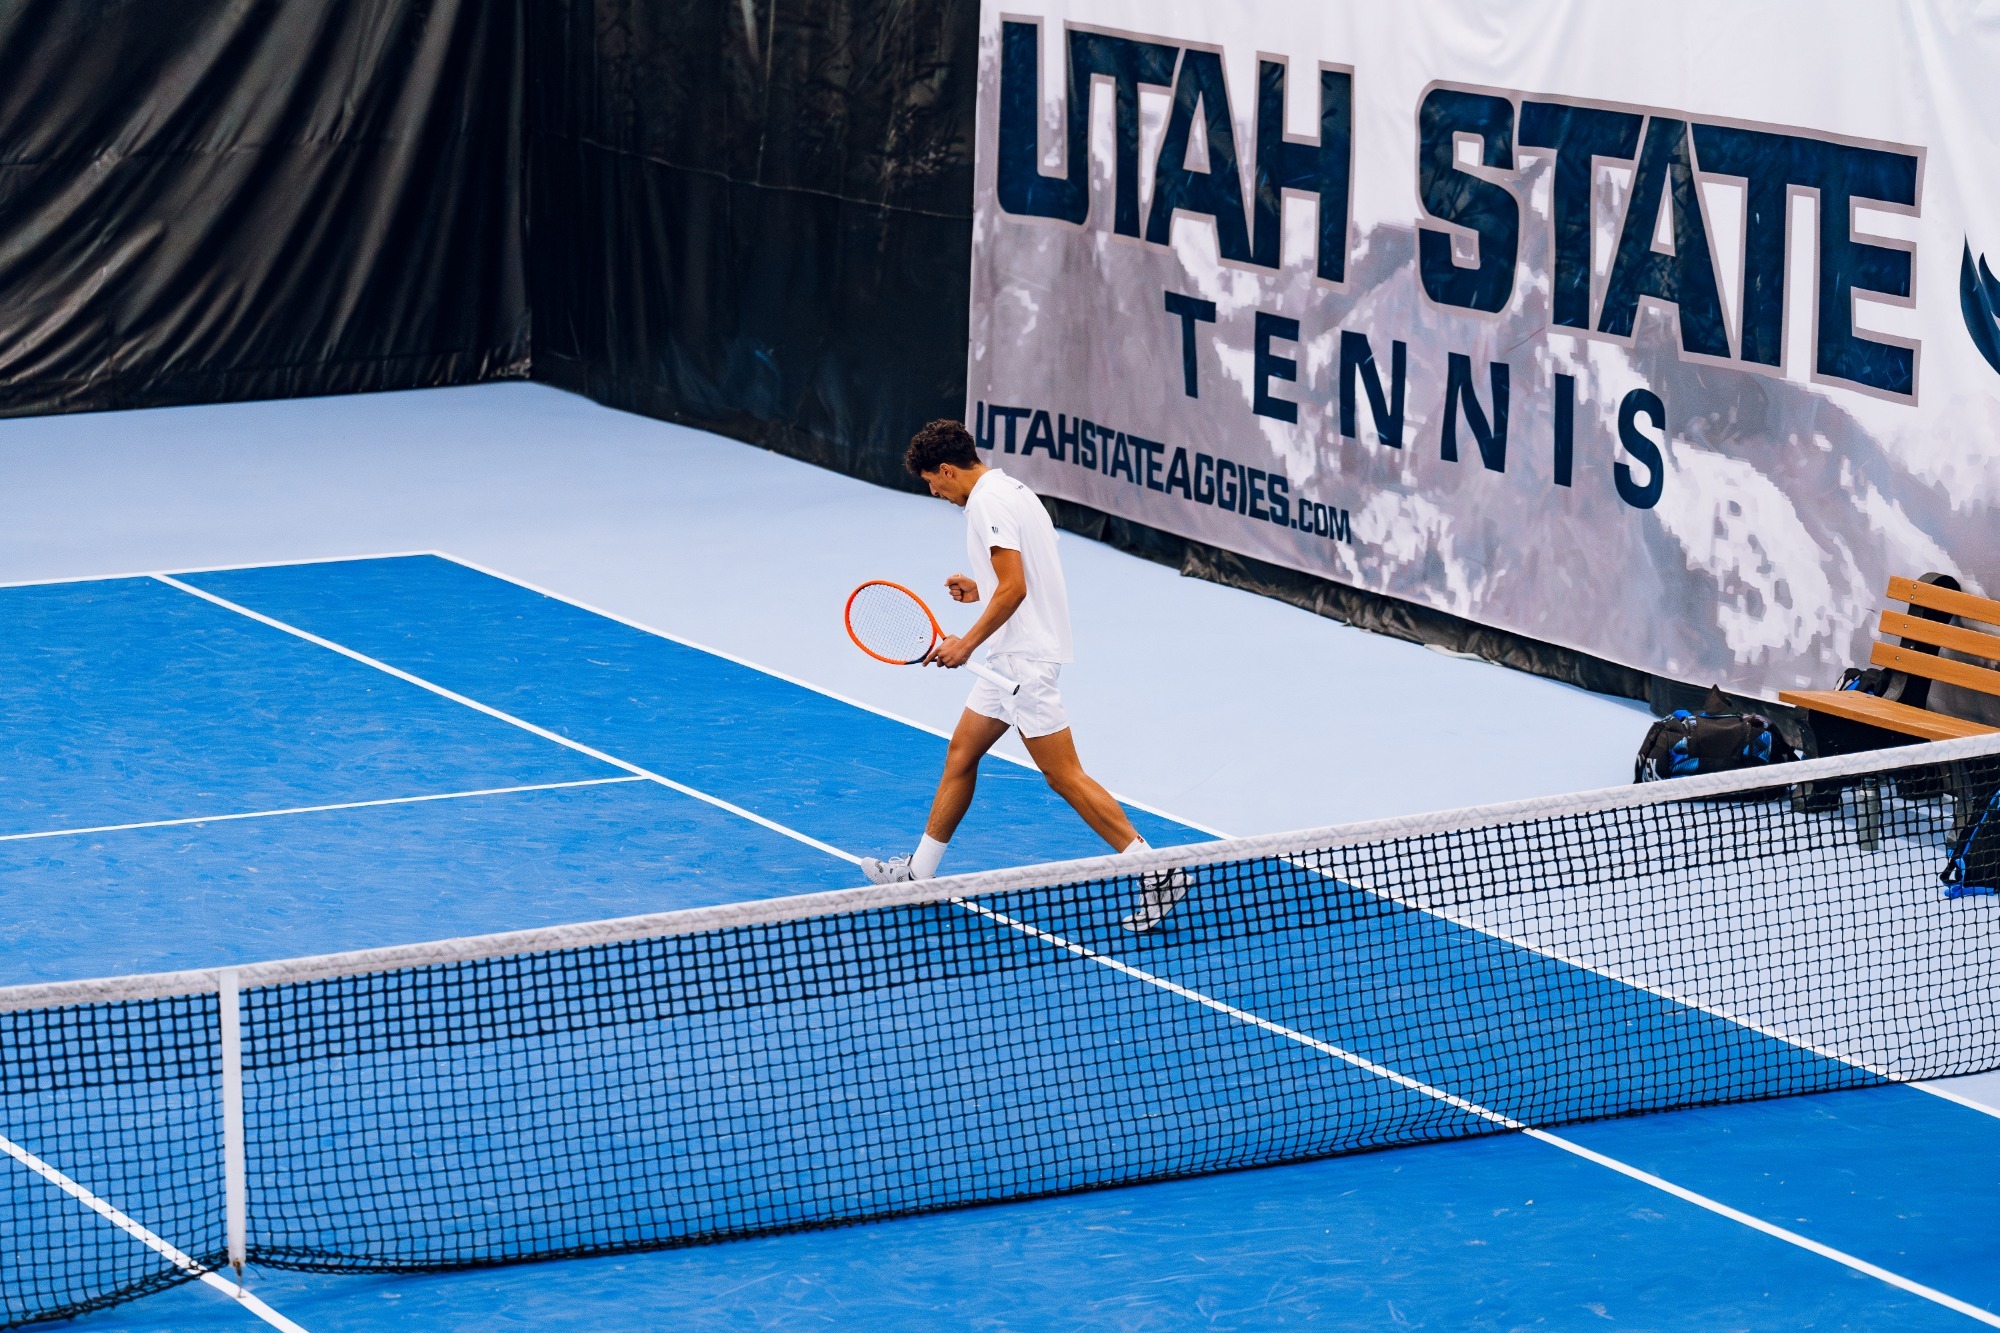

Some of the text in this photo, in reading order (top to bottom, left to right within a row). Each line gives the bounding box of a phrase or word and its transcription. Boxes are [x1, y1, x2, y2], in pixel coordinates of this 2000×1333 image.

[995, 13, 1927, 408] UTAH STATE
[976, 401, 1352, 544] UTAHSTATEAGGIES.COM
[1164, 290, 1667, 510] TENNIS
